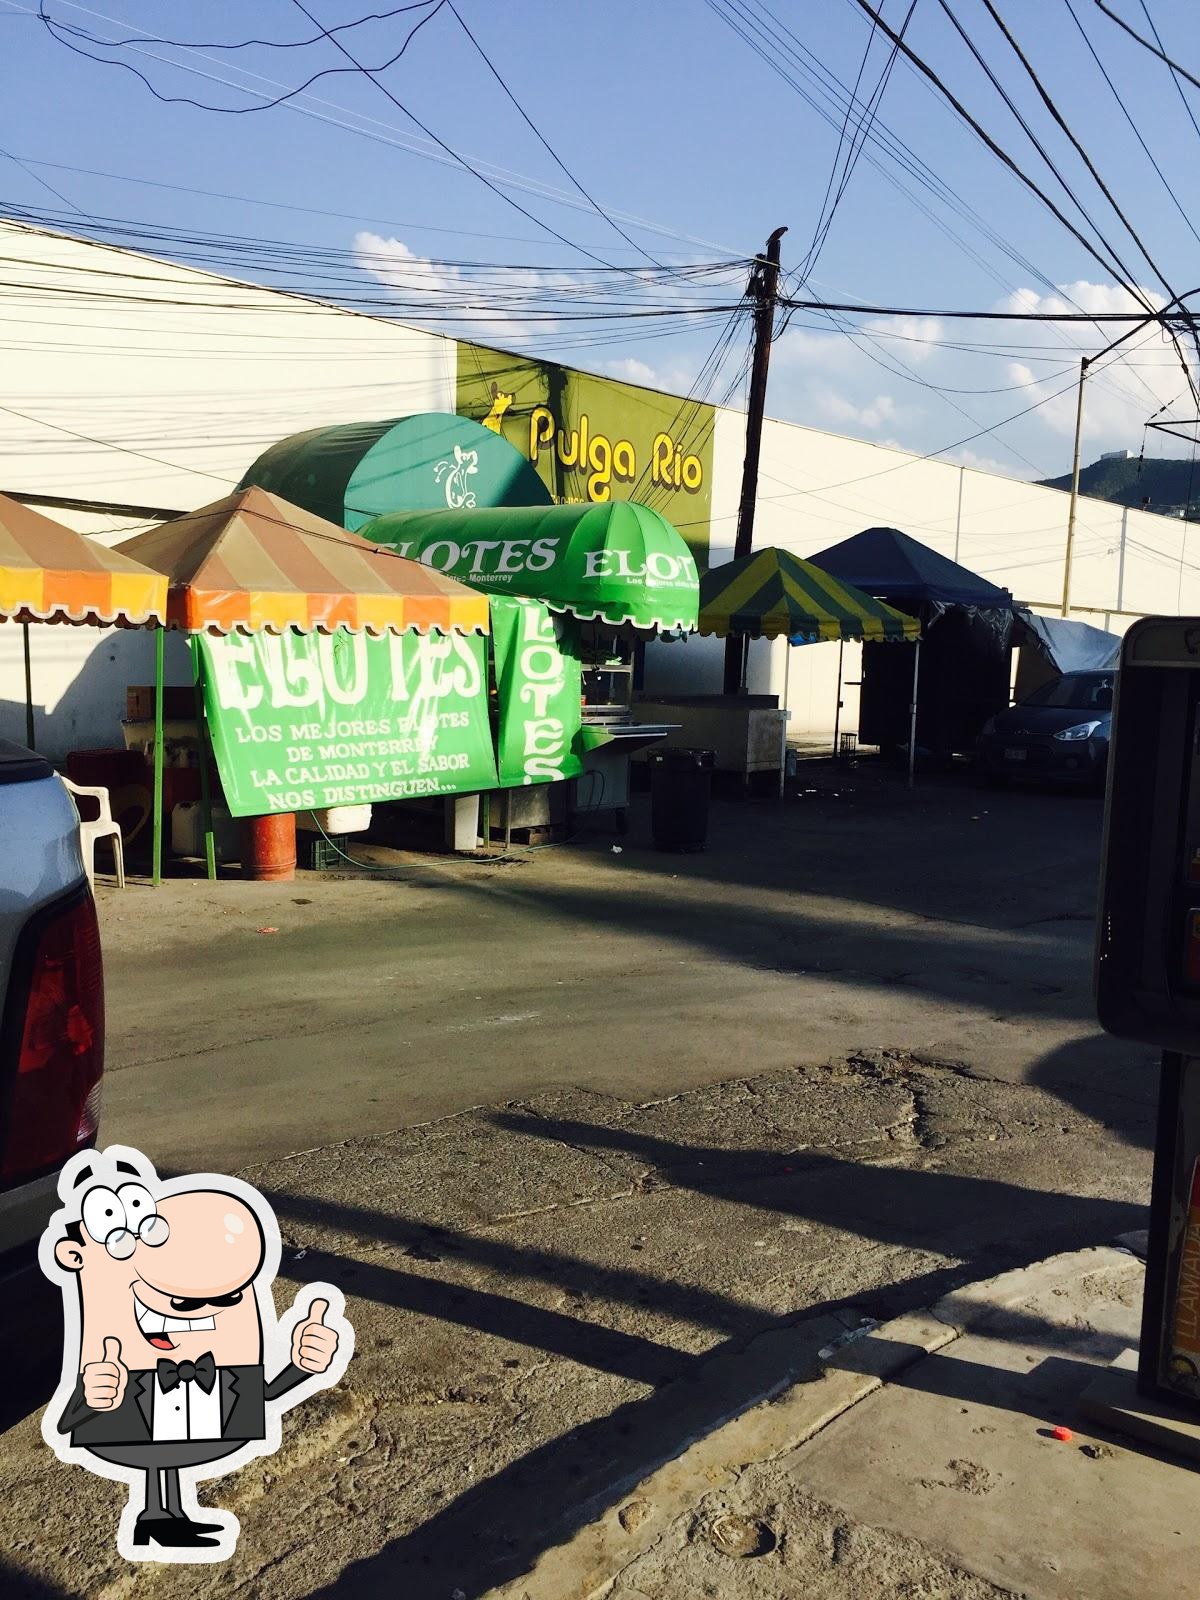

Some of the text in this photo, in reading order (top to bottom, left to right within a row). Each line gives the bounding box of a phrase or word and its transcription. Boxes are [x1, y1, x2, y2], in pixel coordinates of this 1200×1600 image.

[529, 406, 636, 502] Pulga
[378, 538, 561, 574] LOTES
[469, 574, 513, 583] Monterrey
[235, 725, 282, 744] LOS
[289, 718, 391, 741] MEJORES
[286, 735, 438, 763] DE MONTERREY
[250, 753, 470, 787] LA CALIDAD Y EL SABOR
[266, 792, 316, 810] NOS
